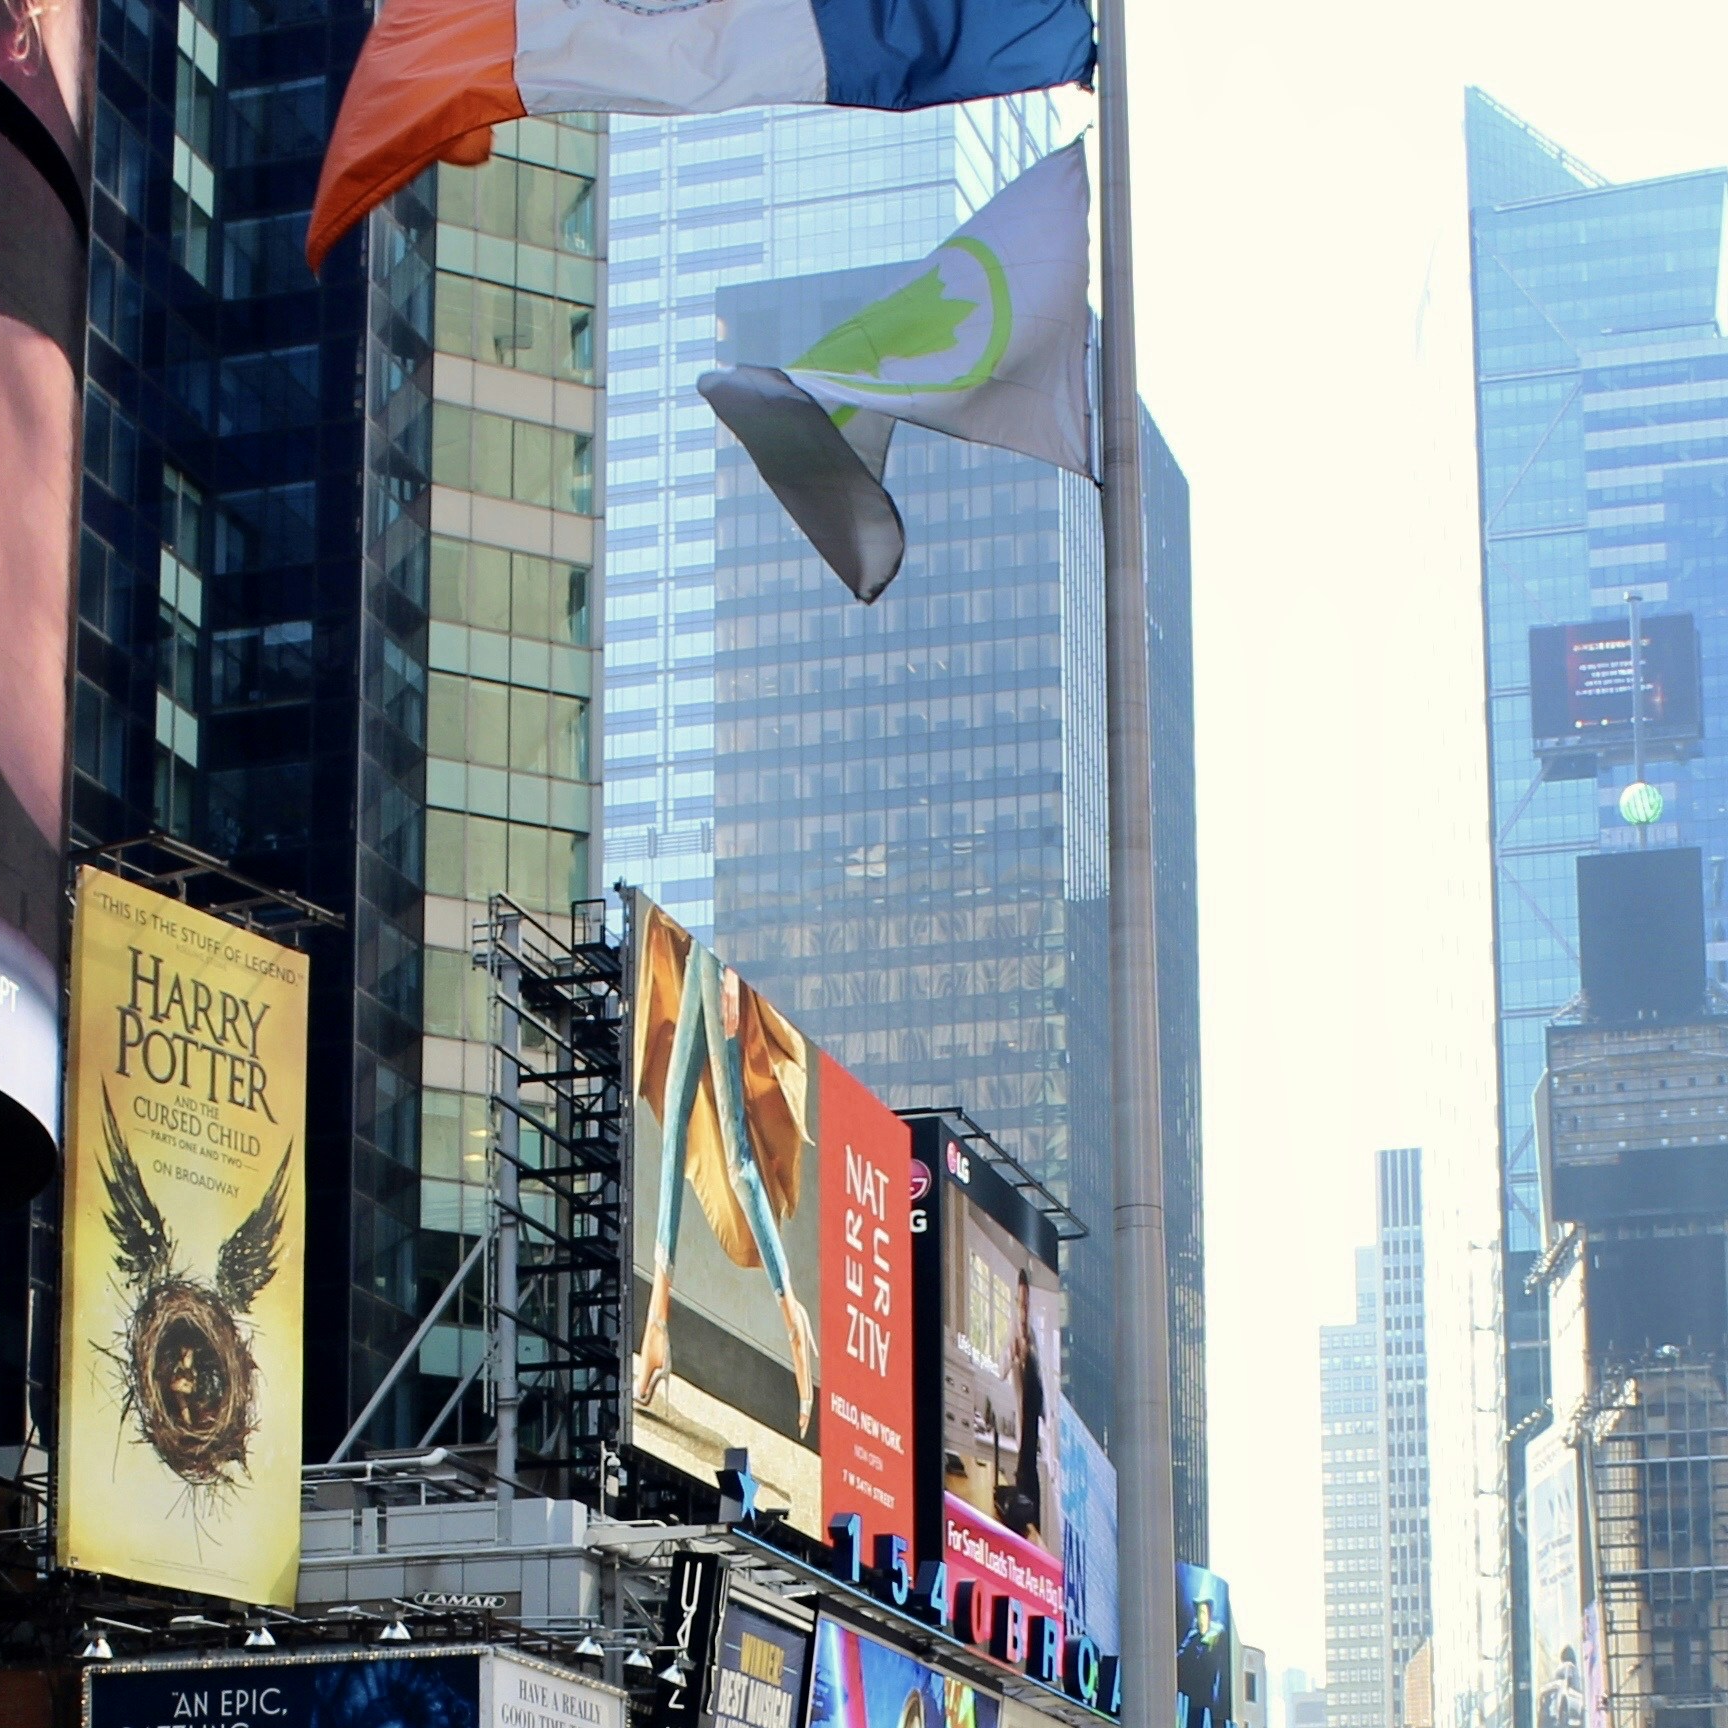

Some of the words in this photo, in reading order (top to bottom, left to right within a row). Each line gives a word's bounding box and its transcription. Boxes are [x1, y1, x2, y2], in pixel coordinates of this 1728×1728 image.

[135, 904, 147, 926] IS
[152, 913, 178, 939] THE
[181, 927, 221, 954] STUFF
[223, 944, 241, 964] OF
[127, 945, 271, 1060] HARRY
[116, 1005, 279, 1124] POTTER
[133, 1096, 202, 1137] CURSED
[207, 1122, 261, 1157] CHILD
[173, 1095, 197, 1114] AND
[200, 1101, 219, 1119] THE
[150, 1130, 177, 1150] PARTS
[178, 1139, 198, 1155] ONE
[199, 1145, 219, 1161] AND
[221, 1153, 243, 1169] TWO
[956, 1151, 971, 1184] LG
[153, 1159, 172, 1178] ON
[174, 1165, 240, 1199] BROADWAY
[831, 1392, 859, 1430] HELLO,
[861, 1411, 879, 1438] NEW
[880, 1423, 905, 1455] YORK.
[872, 1486, 895, 1510] STREET
[844, 1512, 983, 1645] 1540
[947, 1520, 961, 1550] For
[962, 1529, 985, 1565] Small
[985, 1541, 1007, 1579] Loads
[1007, 1552, 1025, 1584] That
[1025, 1568, 1040, 1593] Are
[220, 1686, 288, 1718] EPIC,
[519, 1679, 548, 1707] HAVE
[553, 1695, 559, 1712] A
[562, 1696, 601, 1726] REALLY
[718, 1667, 748, 1720] BEST
